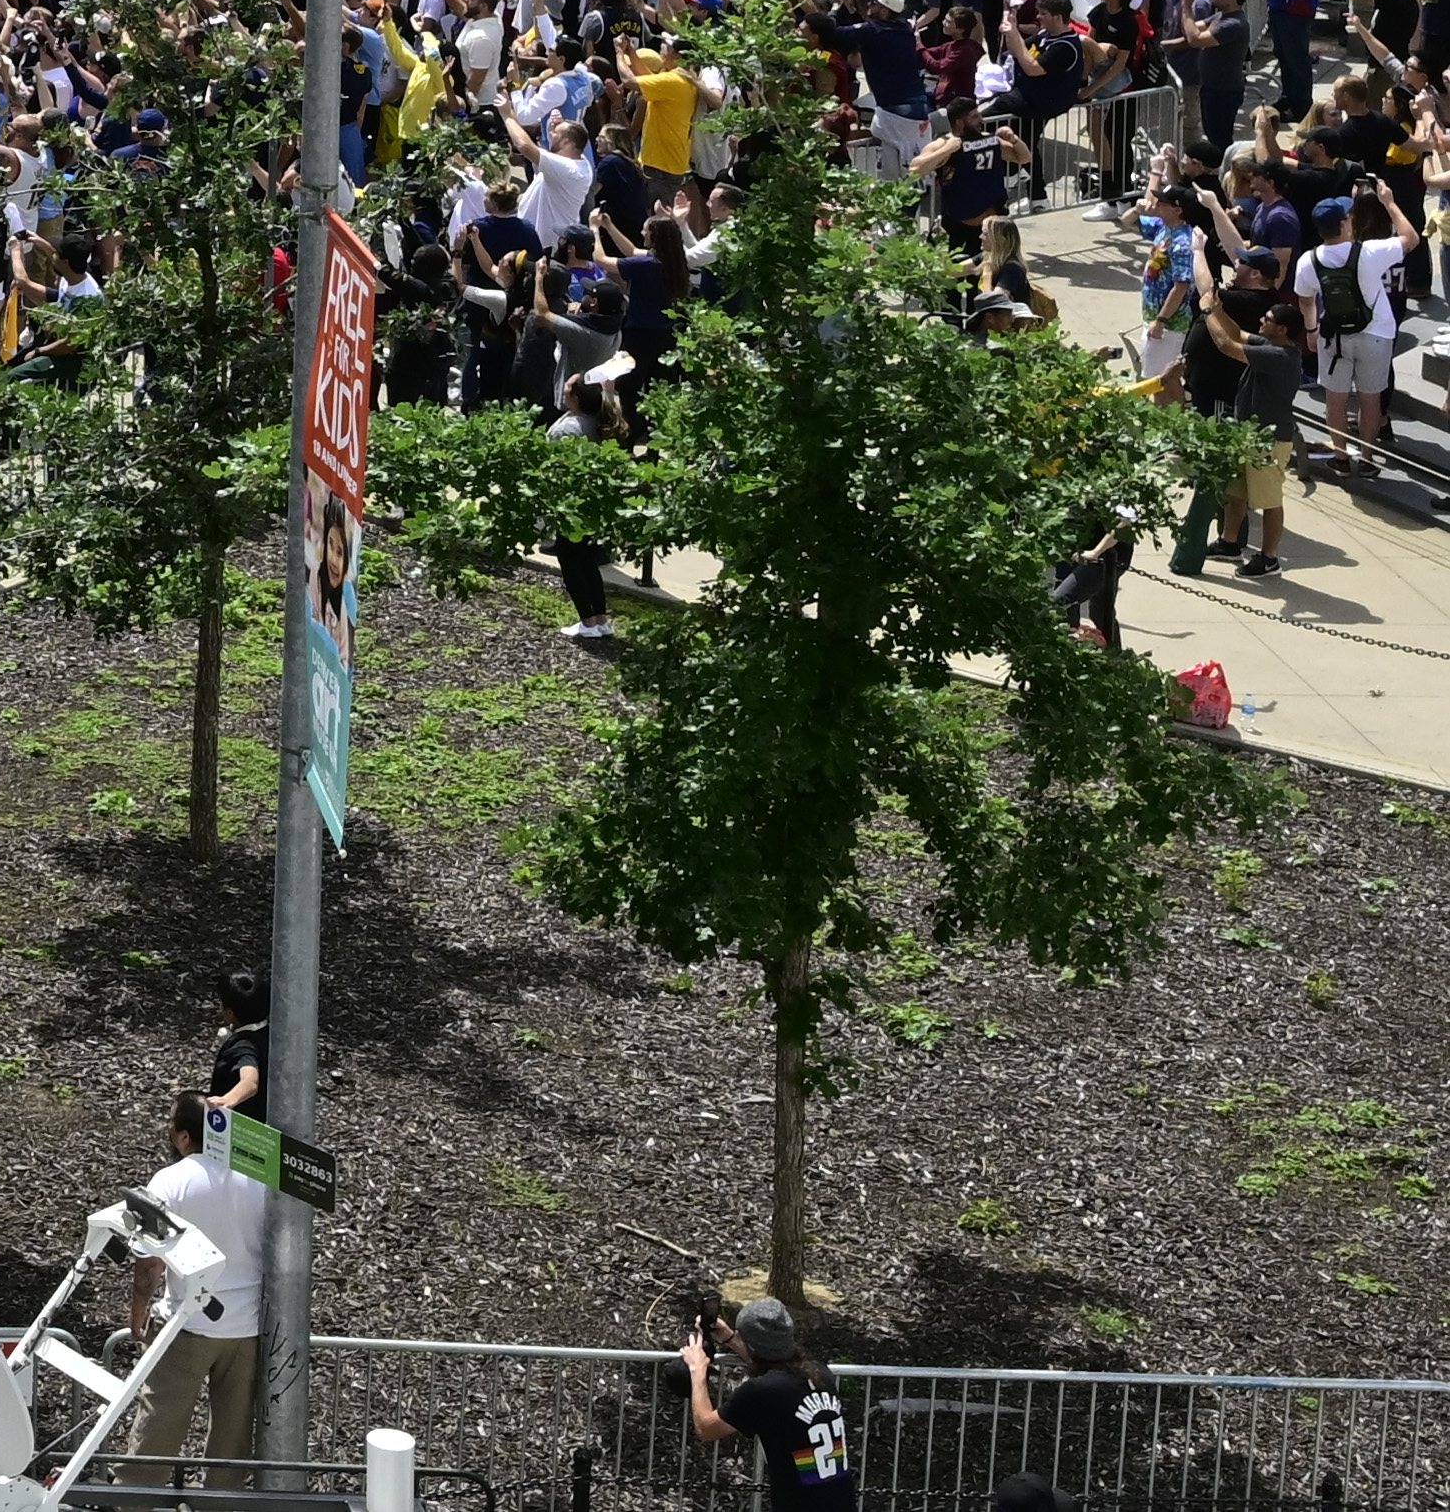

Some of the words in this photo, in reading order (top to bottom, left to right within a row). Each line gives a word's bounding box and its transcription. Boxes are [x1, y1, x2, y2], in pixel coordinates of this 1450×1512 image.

[975, 150, 994, 171] 27
[324, 246, 369, 342] FREE
[332, 332, 354, 379] FOR
[314, 367, 363, 468] KIDS
[312, 439, 321, 455] 18
[321, 447, 338, 476] AND
[311, 647, 338, 691] DENVER
[283, 1153, 333, 1184] 3032863
[795, 1390, 842, 1424] MURRA
[807, 1415, 849, 1480] 27
